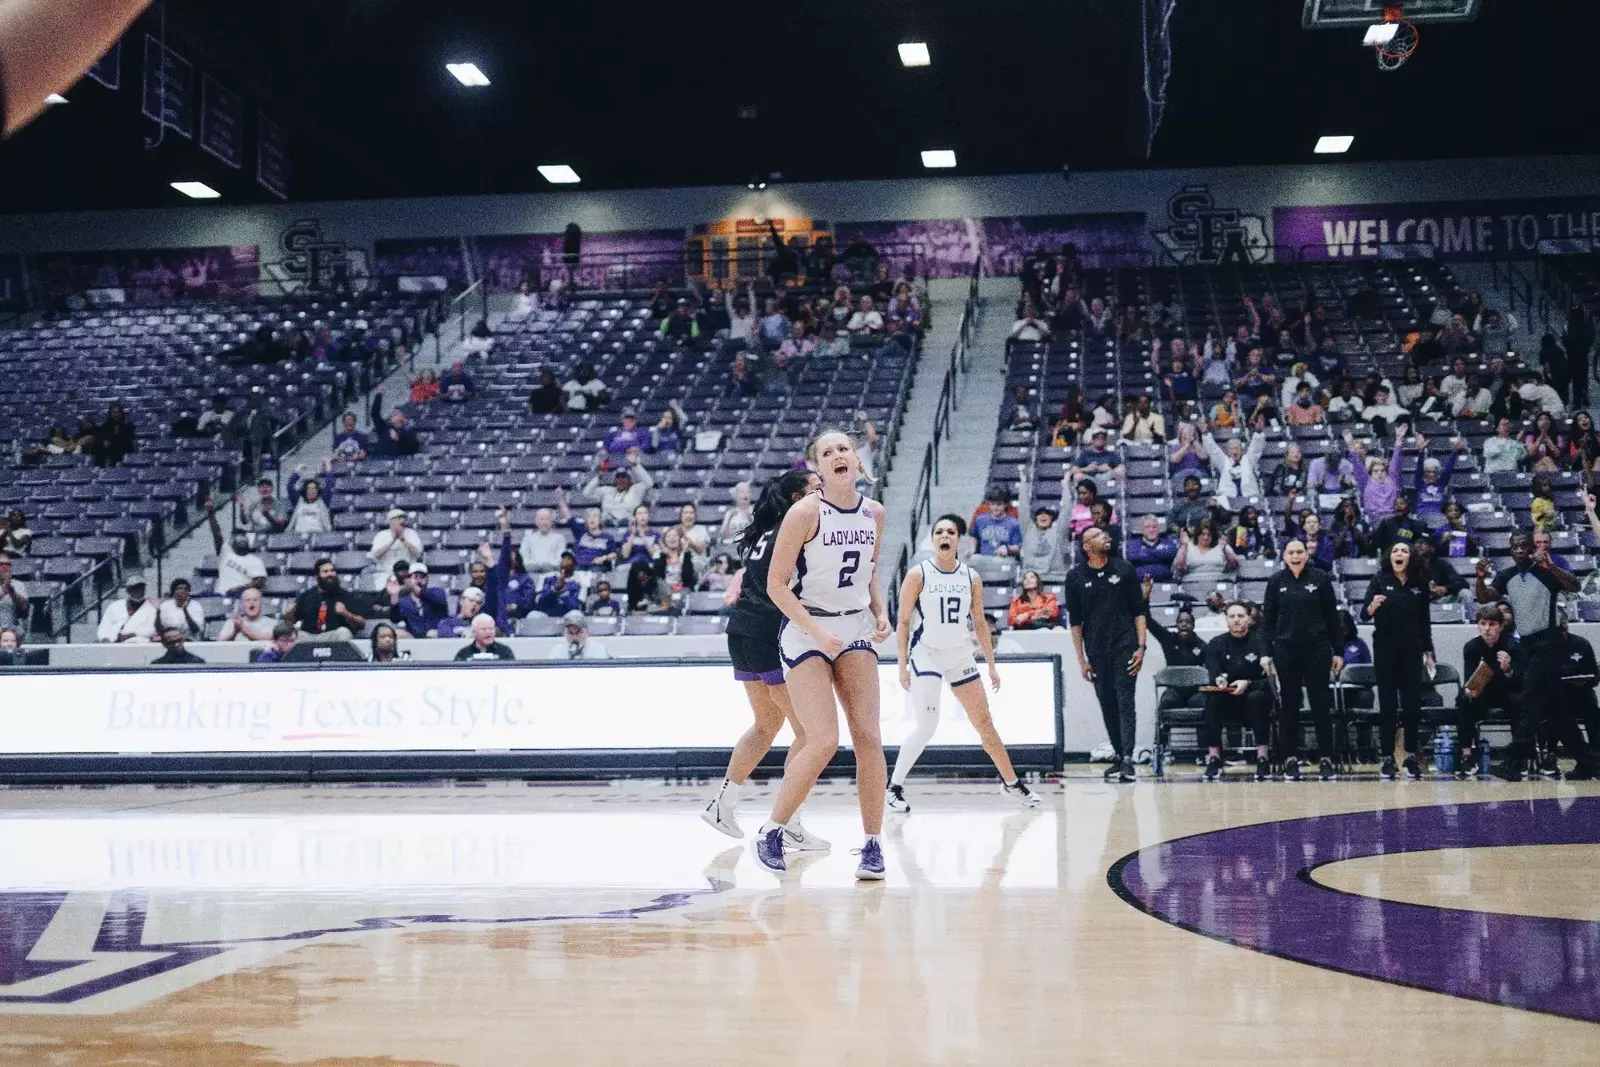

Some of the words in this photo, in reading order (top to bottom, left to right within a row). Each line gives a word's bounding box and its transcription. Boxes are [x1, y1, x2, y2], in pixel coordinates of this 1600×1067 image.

[1323, 216, 1494, 257] WELCOME
[1501, 214, 1540, 250] TO
[837, 550, 860, 588] 2
[940, 596, 961, 624] 12
[107, 688, 272, 740] Banking
[290, 687, 403, 728] Texas
[421, 685, 532, 738] Style.
